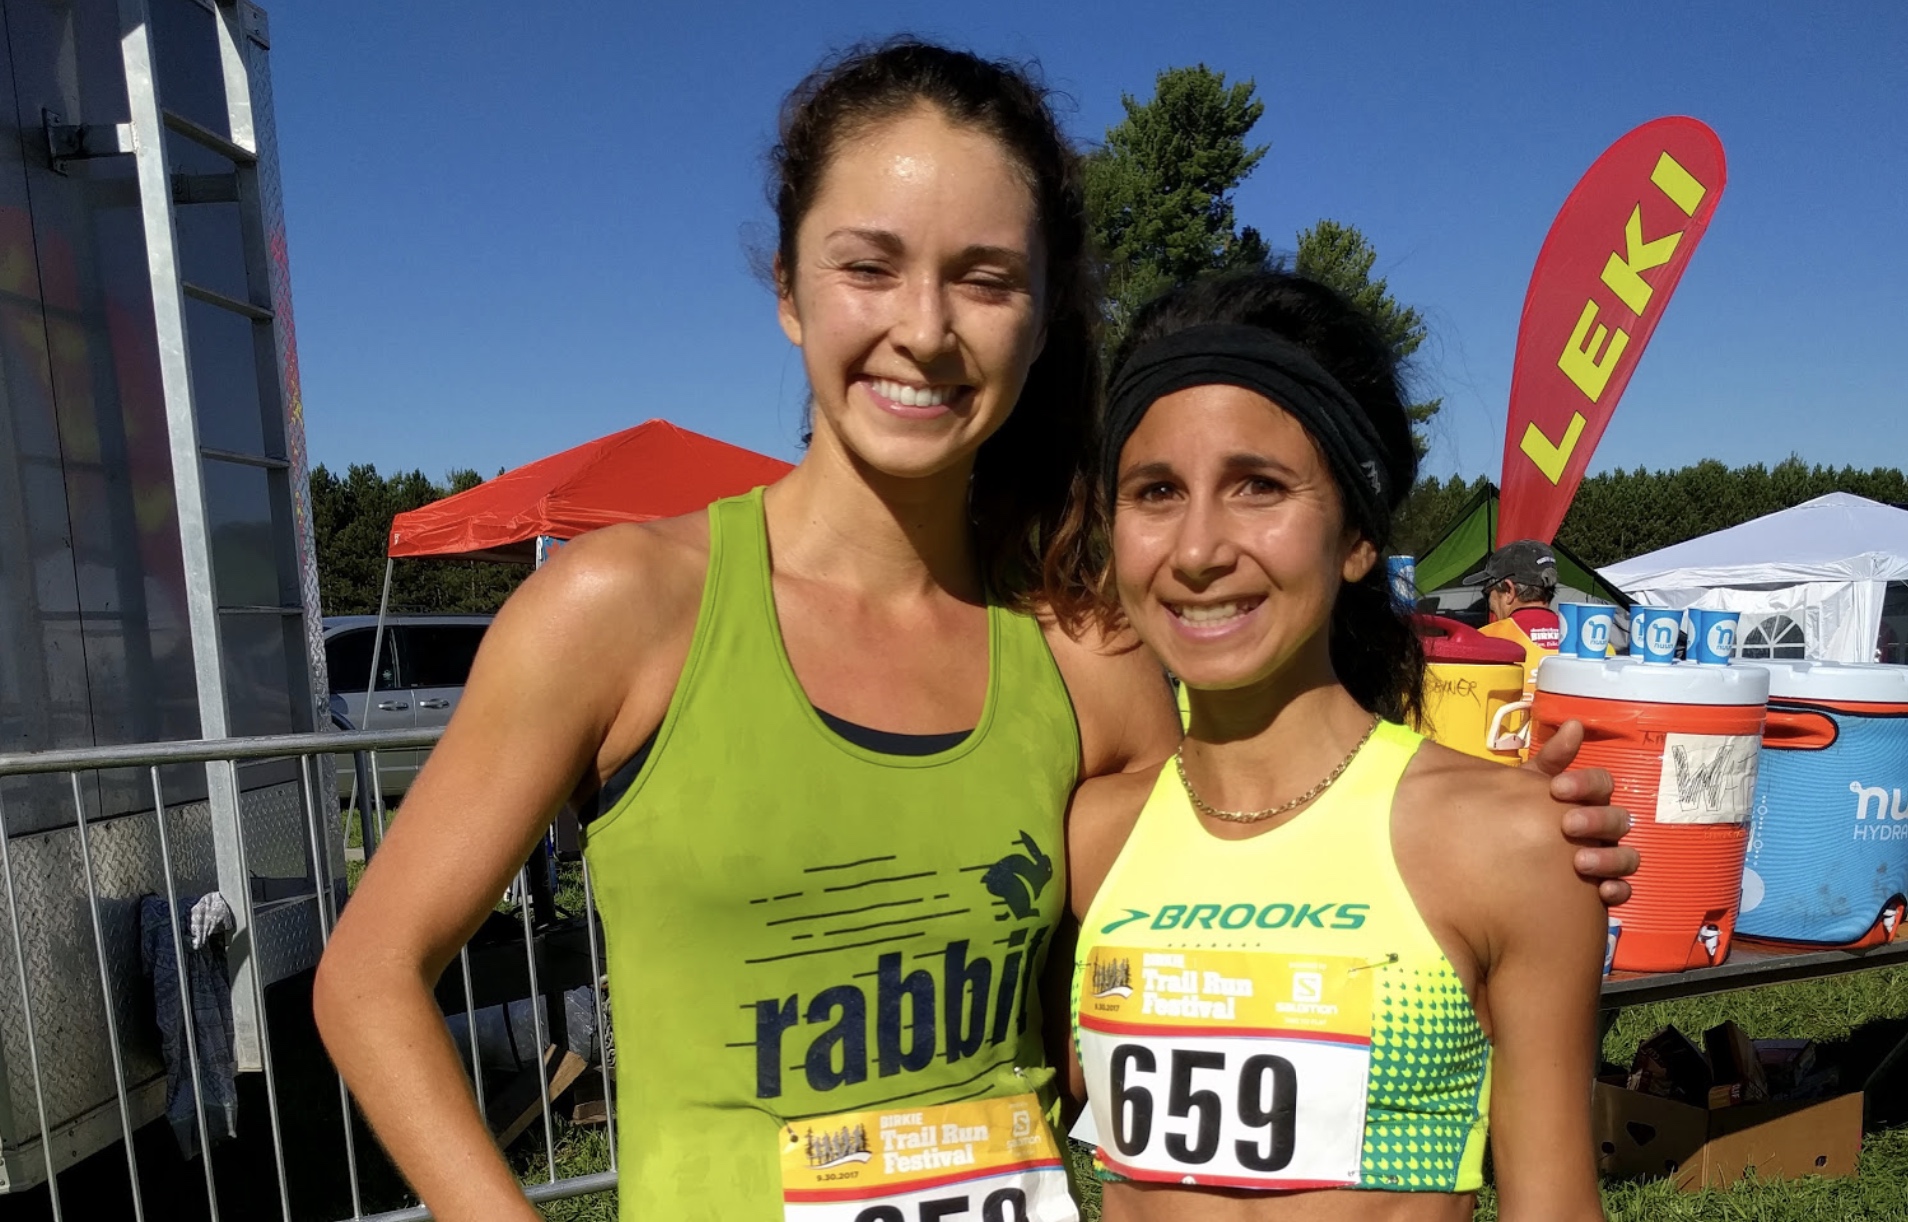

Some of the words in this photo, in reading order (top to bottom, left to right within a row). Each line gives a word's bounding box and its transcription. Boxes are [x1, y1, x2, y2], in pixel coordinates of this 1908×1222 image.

[1519, 150, 1707, 486] LEKI
[1150, 903, 1371, 930] BROOKS
[1142, 968, 1198, 993] Trail
[1203, 971, 1253, 997] Run
[1142, 992, 1236, 1020] Festival
[880, 1112, 924, 1130] BIRKIE
[1110, 1044, 1298, 1172] 659
[880, 1124, 937, 1151] Trail
[942, 1123, 989, 1145] Run
[883, 1144, 975, 1175] Festival
[816, 1171, 859, 1182] 9.30.2017
